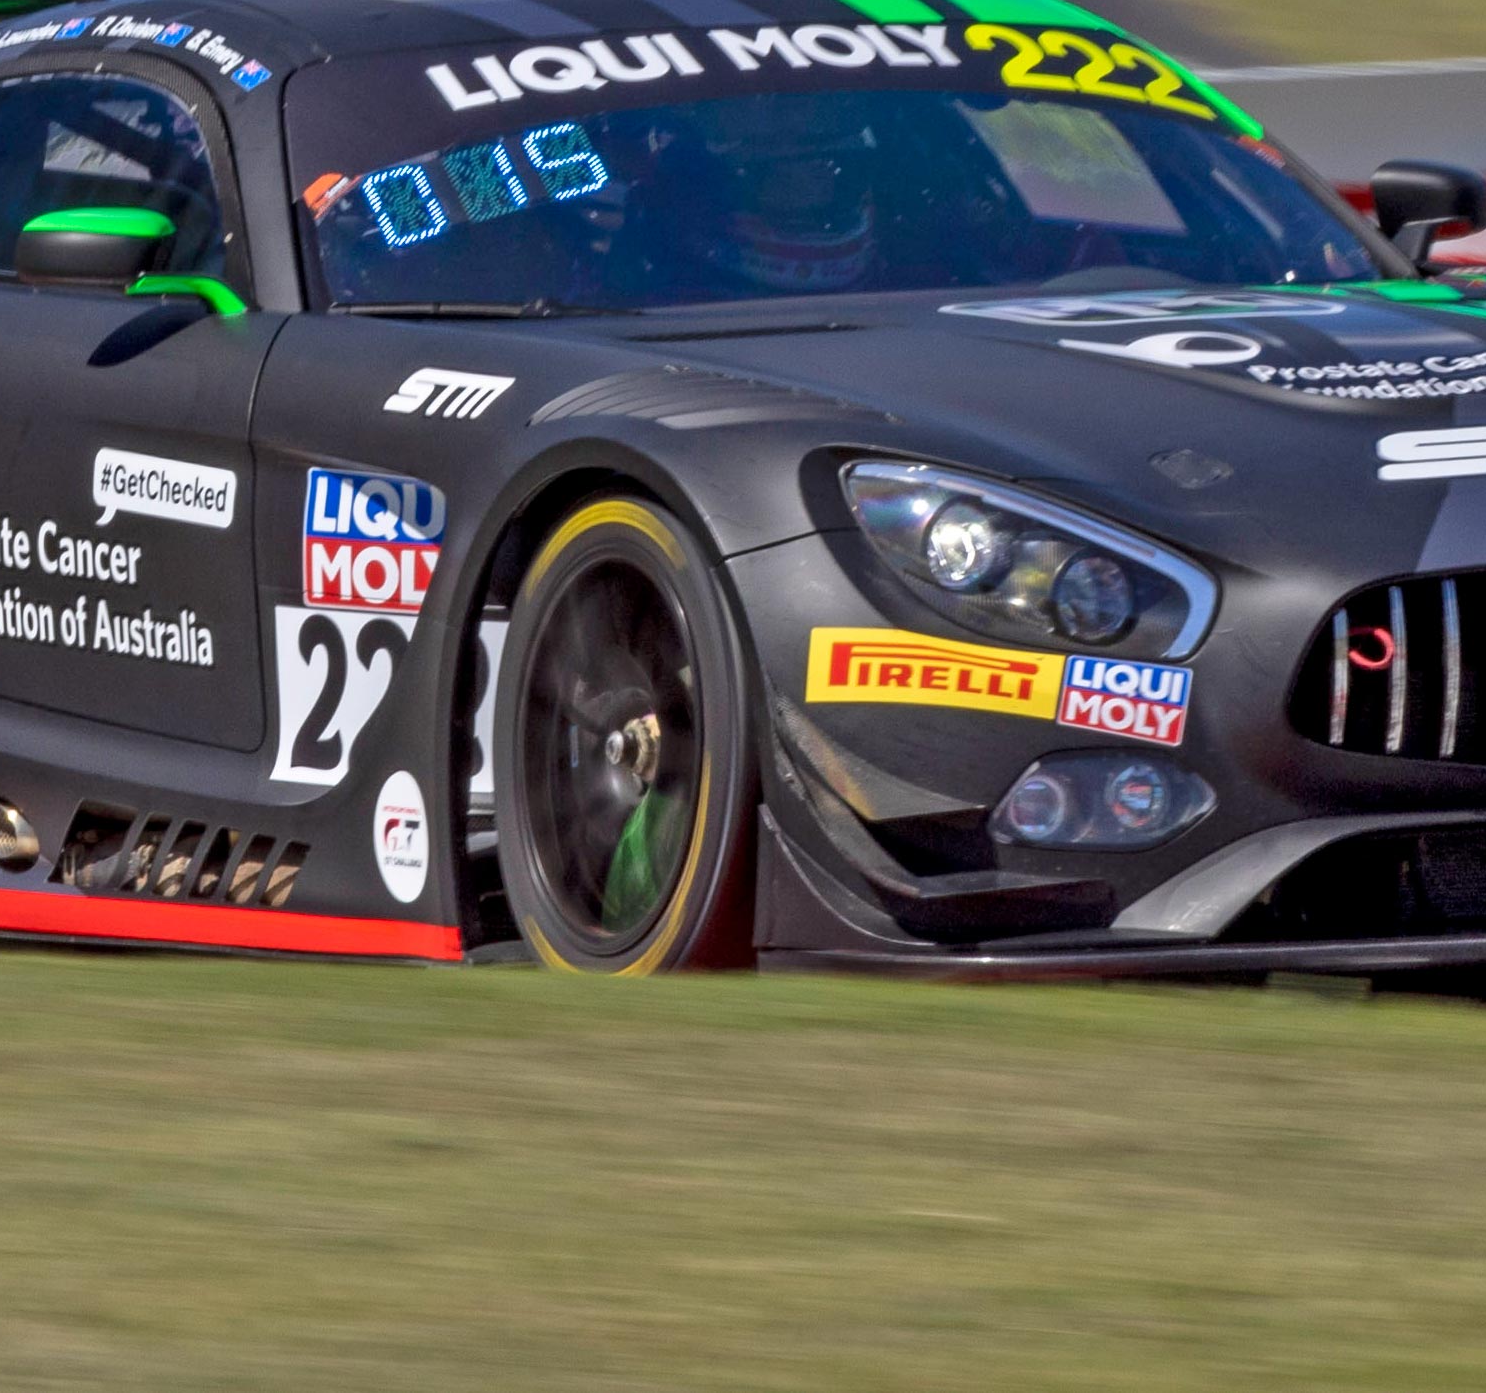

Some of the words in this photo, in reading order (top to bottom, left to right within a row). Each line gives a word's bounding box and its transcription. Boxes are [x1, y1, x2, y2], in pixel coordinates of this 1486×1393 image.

[425, 33, 706, 112] LIQUI
[709, 22, 963, 72] MOLY
[965, 22, 1218, 121] 222
[383, 367, 516, 419] STM
[1247, 360, 1424, 383] Prostate
[100, 462, 229, 513] #GetChecked
[312, 475, 446, 541] LIQU
[37, 520, 142, 585] Cancer
[60, 594, 87, 648] of
[92, 599, 215, 667] Australia
[828, 642, 1040, 701] PIRELLI
[1070, 659, 1185, 702] LIQUI
[1065, 690, 1183, 740] MOLY
